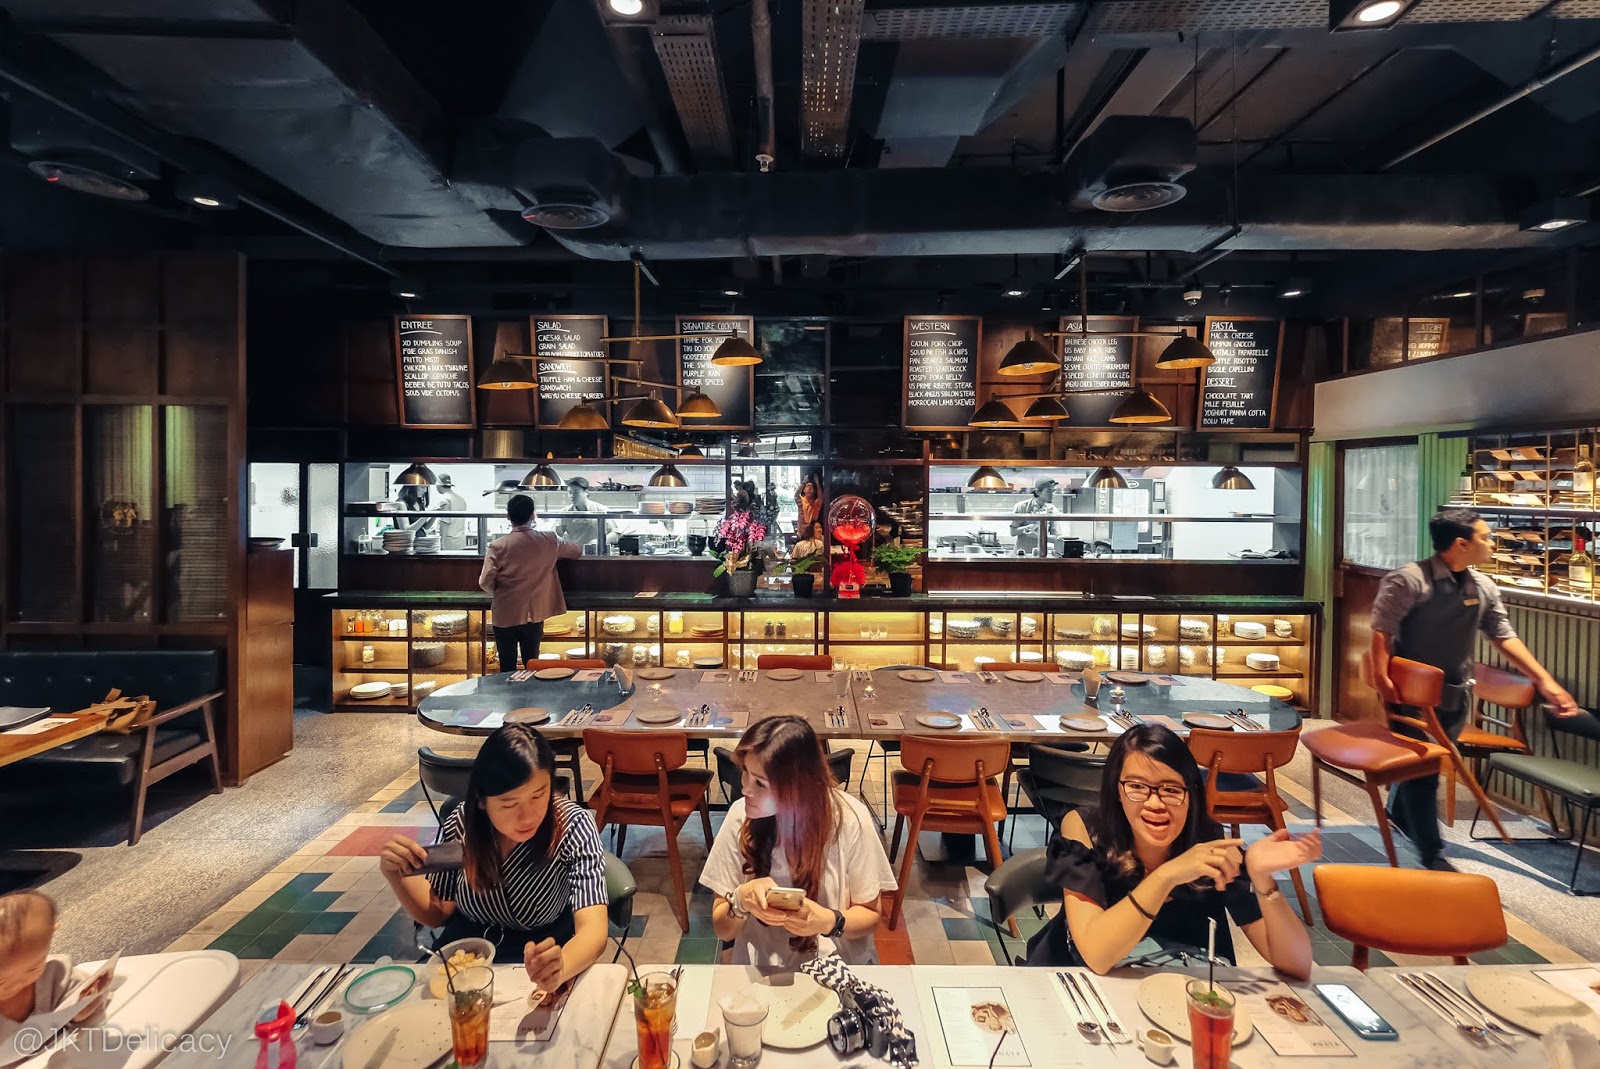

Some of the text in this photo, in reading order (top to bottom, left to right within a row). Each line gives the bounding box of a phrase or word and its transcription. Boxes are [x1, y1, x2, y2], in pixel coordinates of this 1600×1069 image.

[401, 321, 433, 329] ENTREE
[683, 322, 714, 330] SIGNATURE
[1211, 322, 1234, 330] PASTA
